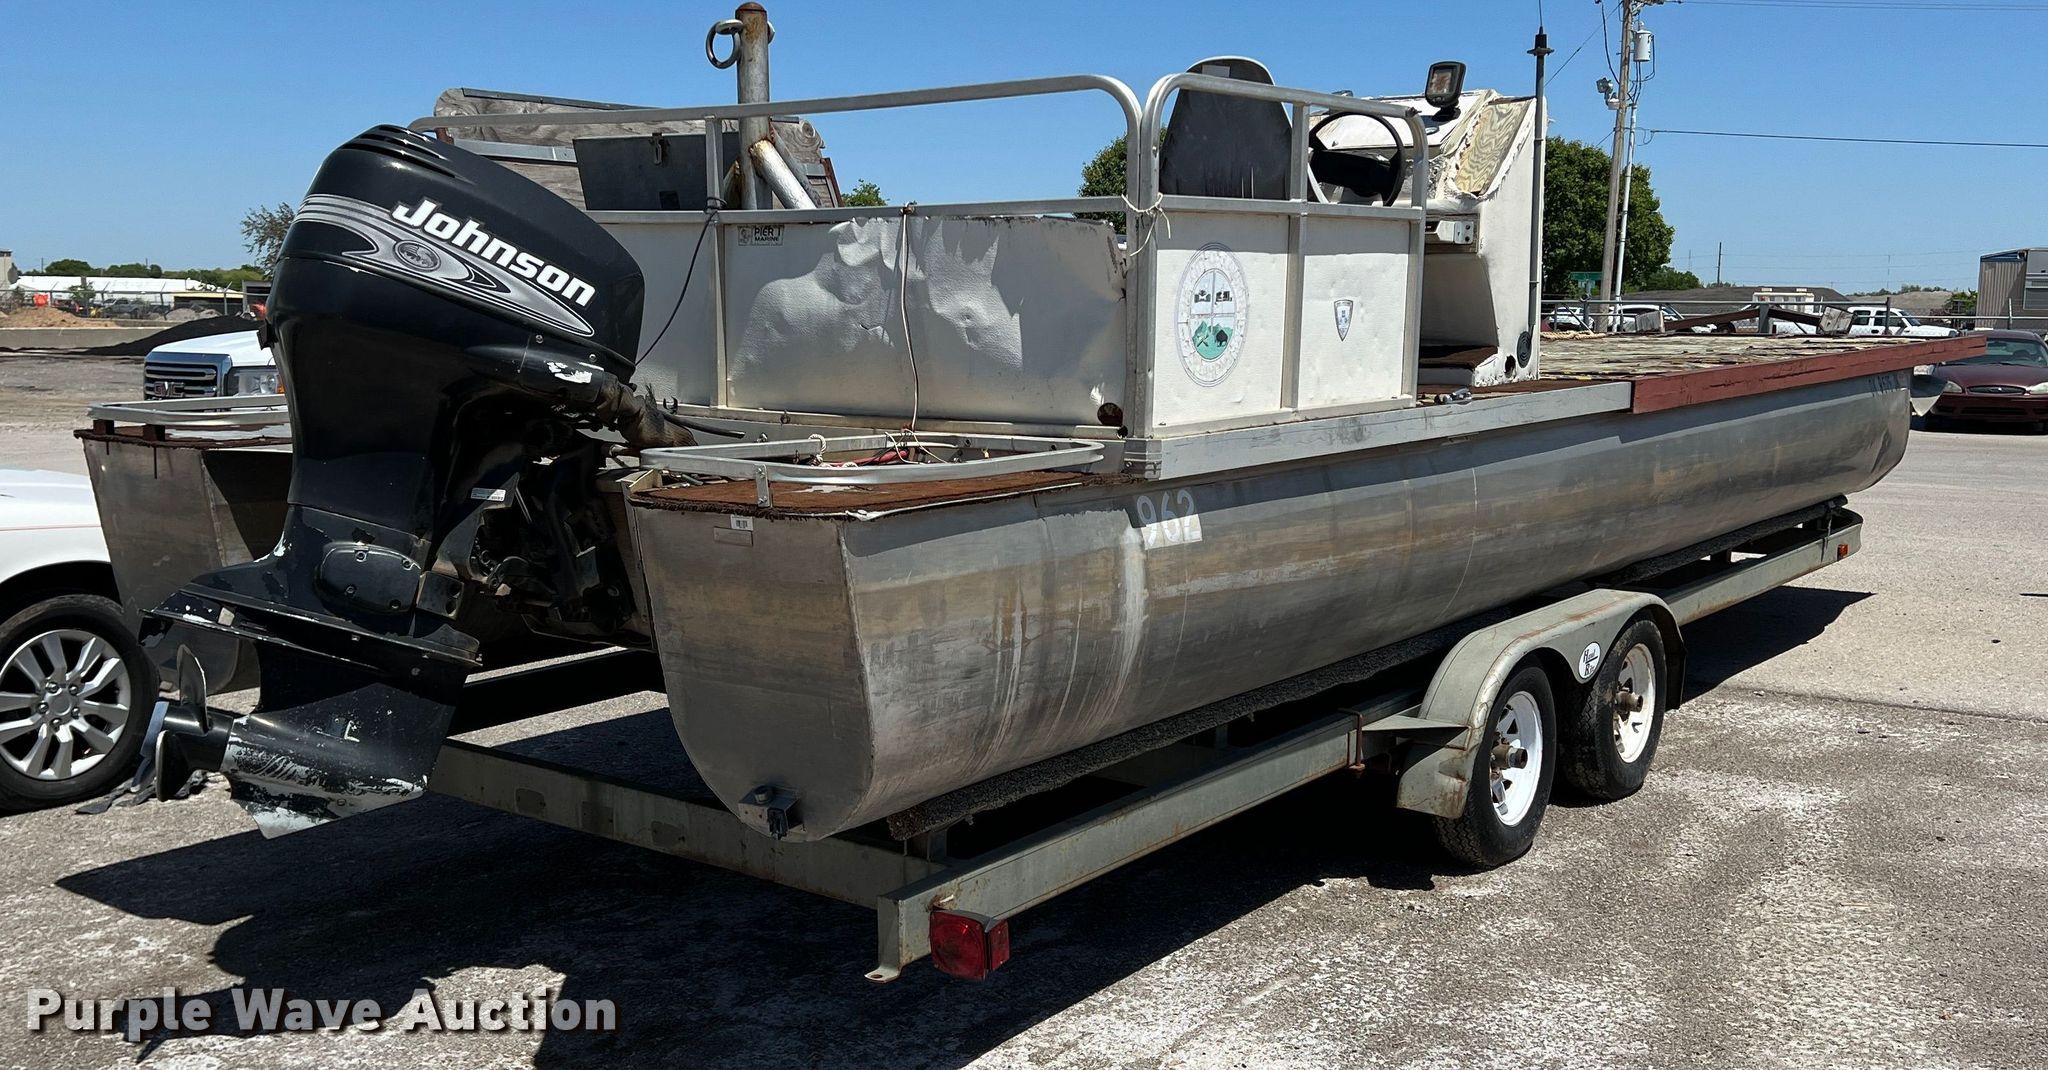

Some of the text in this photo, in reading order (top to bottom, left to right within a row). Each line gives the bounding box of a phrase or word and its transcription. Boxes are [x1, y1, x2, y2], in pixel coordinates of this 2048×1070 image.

[754, 226, 774, 236] PIER
[392, 199, 596, 307] Johnson
[154, 381, 185, 398] GMC
[1136, 489, 1202, 546] 962
